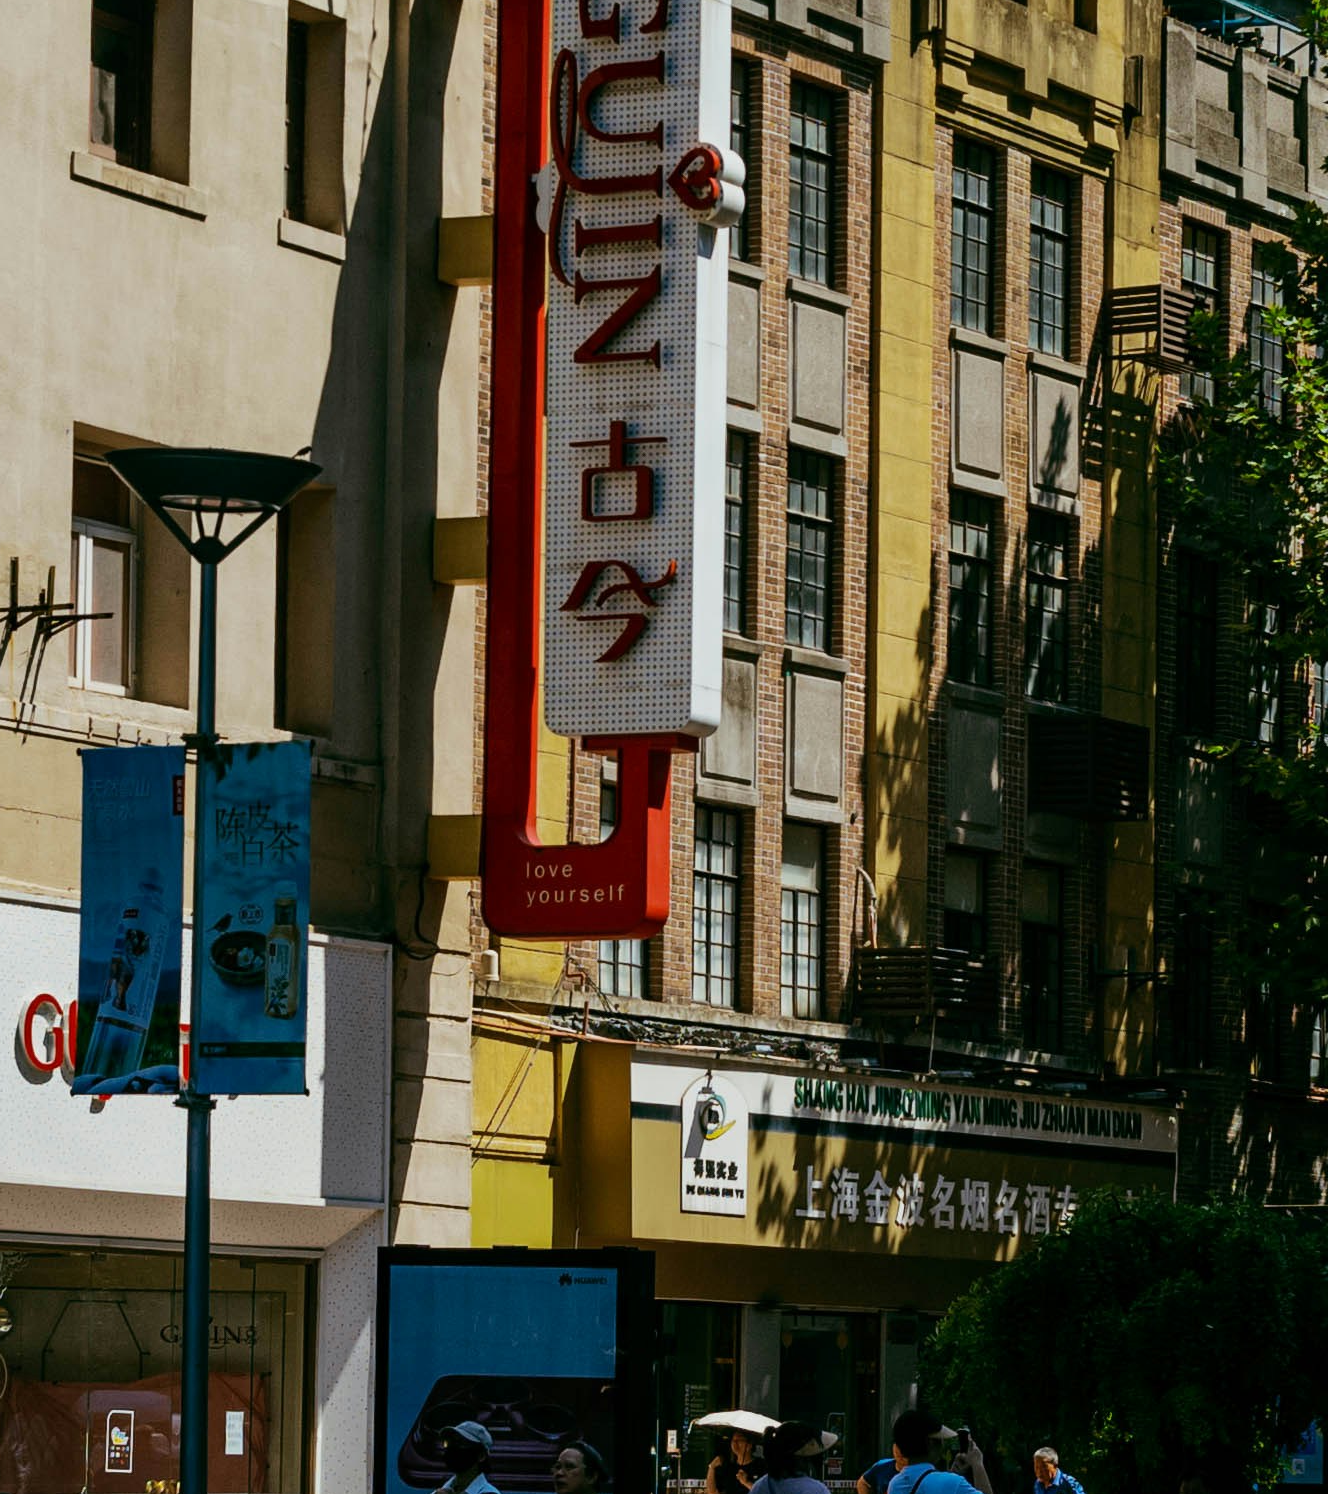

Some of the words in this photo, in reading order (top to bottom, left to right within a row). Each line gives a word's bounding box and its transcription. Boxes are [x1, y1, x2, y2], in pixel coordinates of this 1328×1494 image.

[526, 861, 574, 880] love
[526, 884, 625, 908] yourself
[794, 1076, 844, 1112] SHANG
[846, 1083, 870, 1113] HAI
[915, 1090, 951, 1122] MING
[953, 1094, 981, 1124] YAN
[983, 1097, 1018, 1127] MING
[1019, 1100, 1040, 1129] JIU
[1042, 1102, 1085, 1135] ZHUAN
[1087, 1107, 1110, 1138] MAI
[1113, 1111, 1142, 1140] DIAN
[795, 1164, 1082, 1236] 上海金波名烟名酒专
